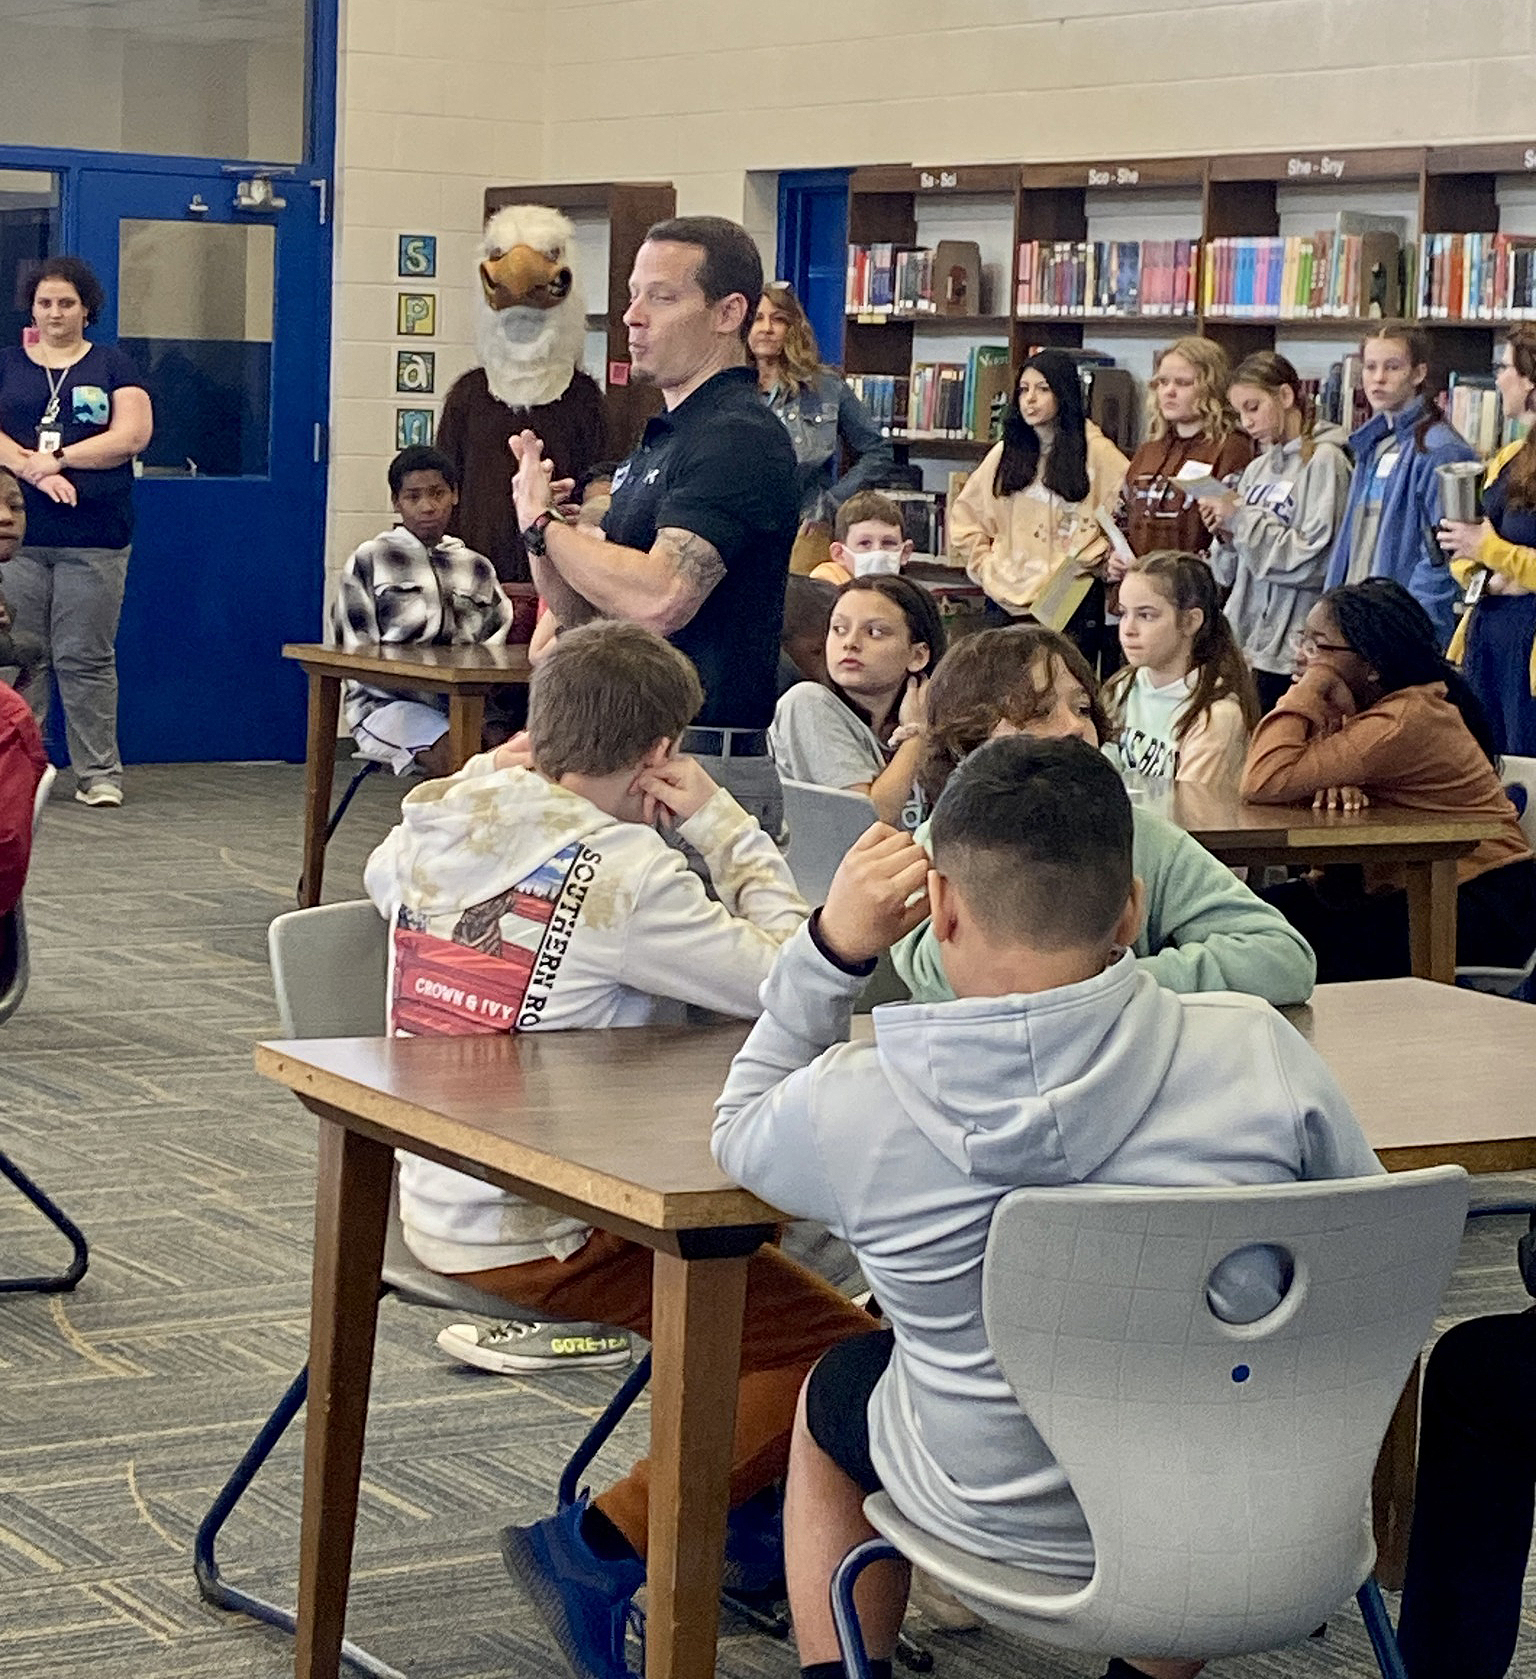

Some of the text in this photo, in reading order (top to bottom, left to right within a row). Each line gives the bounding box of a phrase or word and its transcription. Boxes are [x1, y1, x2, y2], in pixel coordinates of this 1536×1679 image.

[1524, 149, 1536, 169] S
[533, 847, 602, 990] SOUTHERN
[415, 977, 514, 1020] CROWN & IVY
